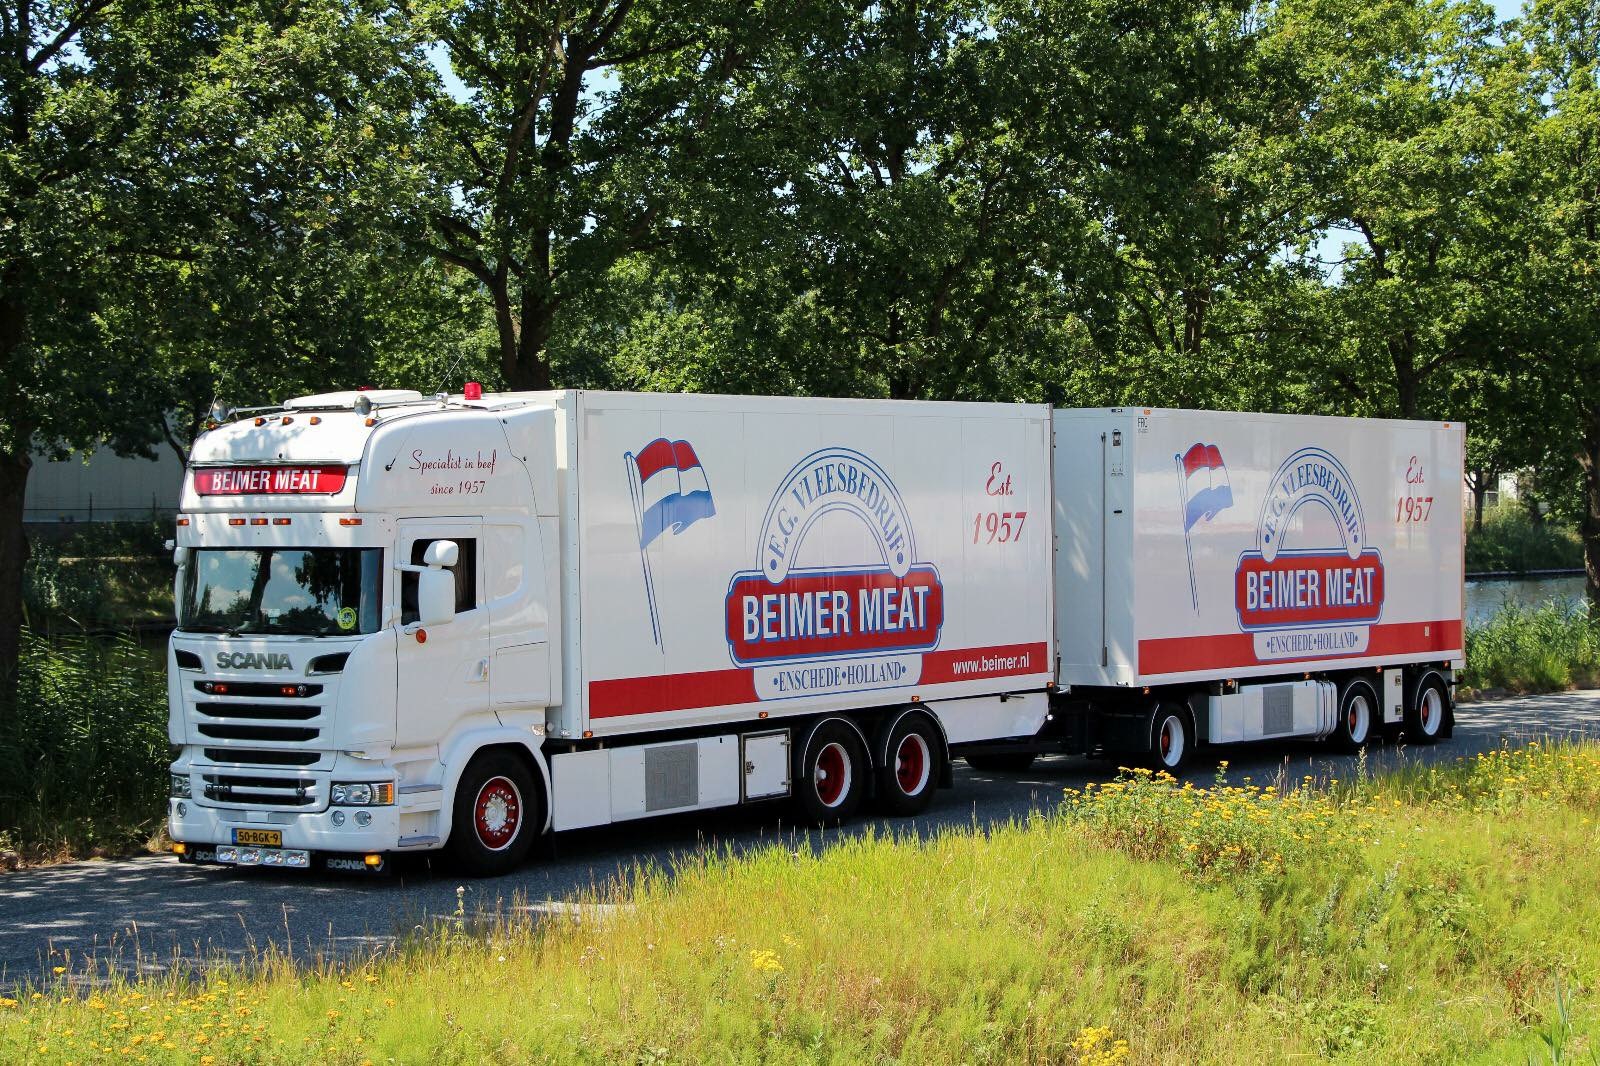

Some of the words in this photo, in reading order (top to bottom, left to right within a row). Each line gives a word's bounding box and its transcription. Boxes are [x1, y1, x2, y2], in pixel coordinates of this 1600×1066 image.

[409, 449, 461, 475] Specialist
[464, 458, 474, 469] in
[477, 449, 497, 475] beef
[1405, 455, 1425, 484] Est.
[211, 470, 271, 491] BEIMER
[274, 469, 322, 490] MEAT
[430, 483, 454, 495] since
[458, 480, 486, 495] 1957
[985, 461, 1014, 497] Est.
[791, 462, 906, 552] VLEESBEDRIJF
[1396, 496, 1434, 523] 1957
[973, 511, 1028, 545] 1957
[1245, 569, 1321, 611] BEIMER
[1324, 566, 1376, 606] MEAT
[742, 590, 850, 641] BEIMER
[858, 585, 930, 632] MEAT
[216, 651, 294, 671] SCANIA
[952, 651, 1030, 675] www.beimer.nl
[238, 831, 279, 844] 50-BGK-9
[327, 858, 367, 871] SCANIA
